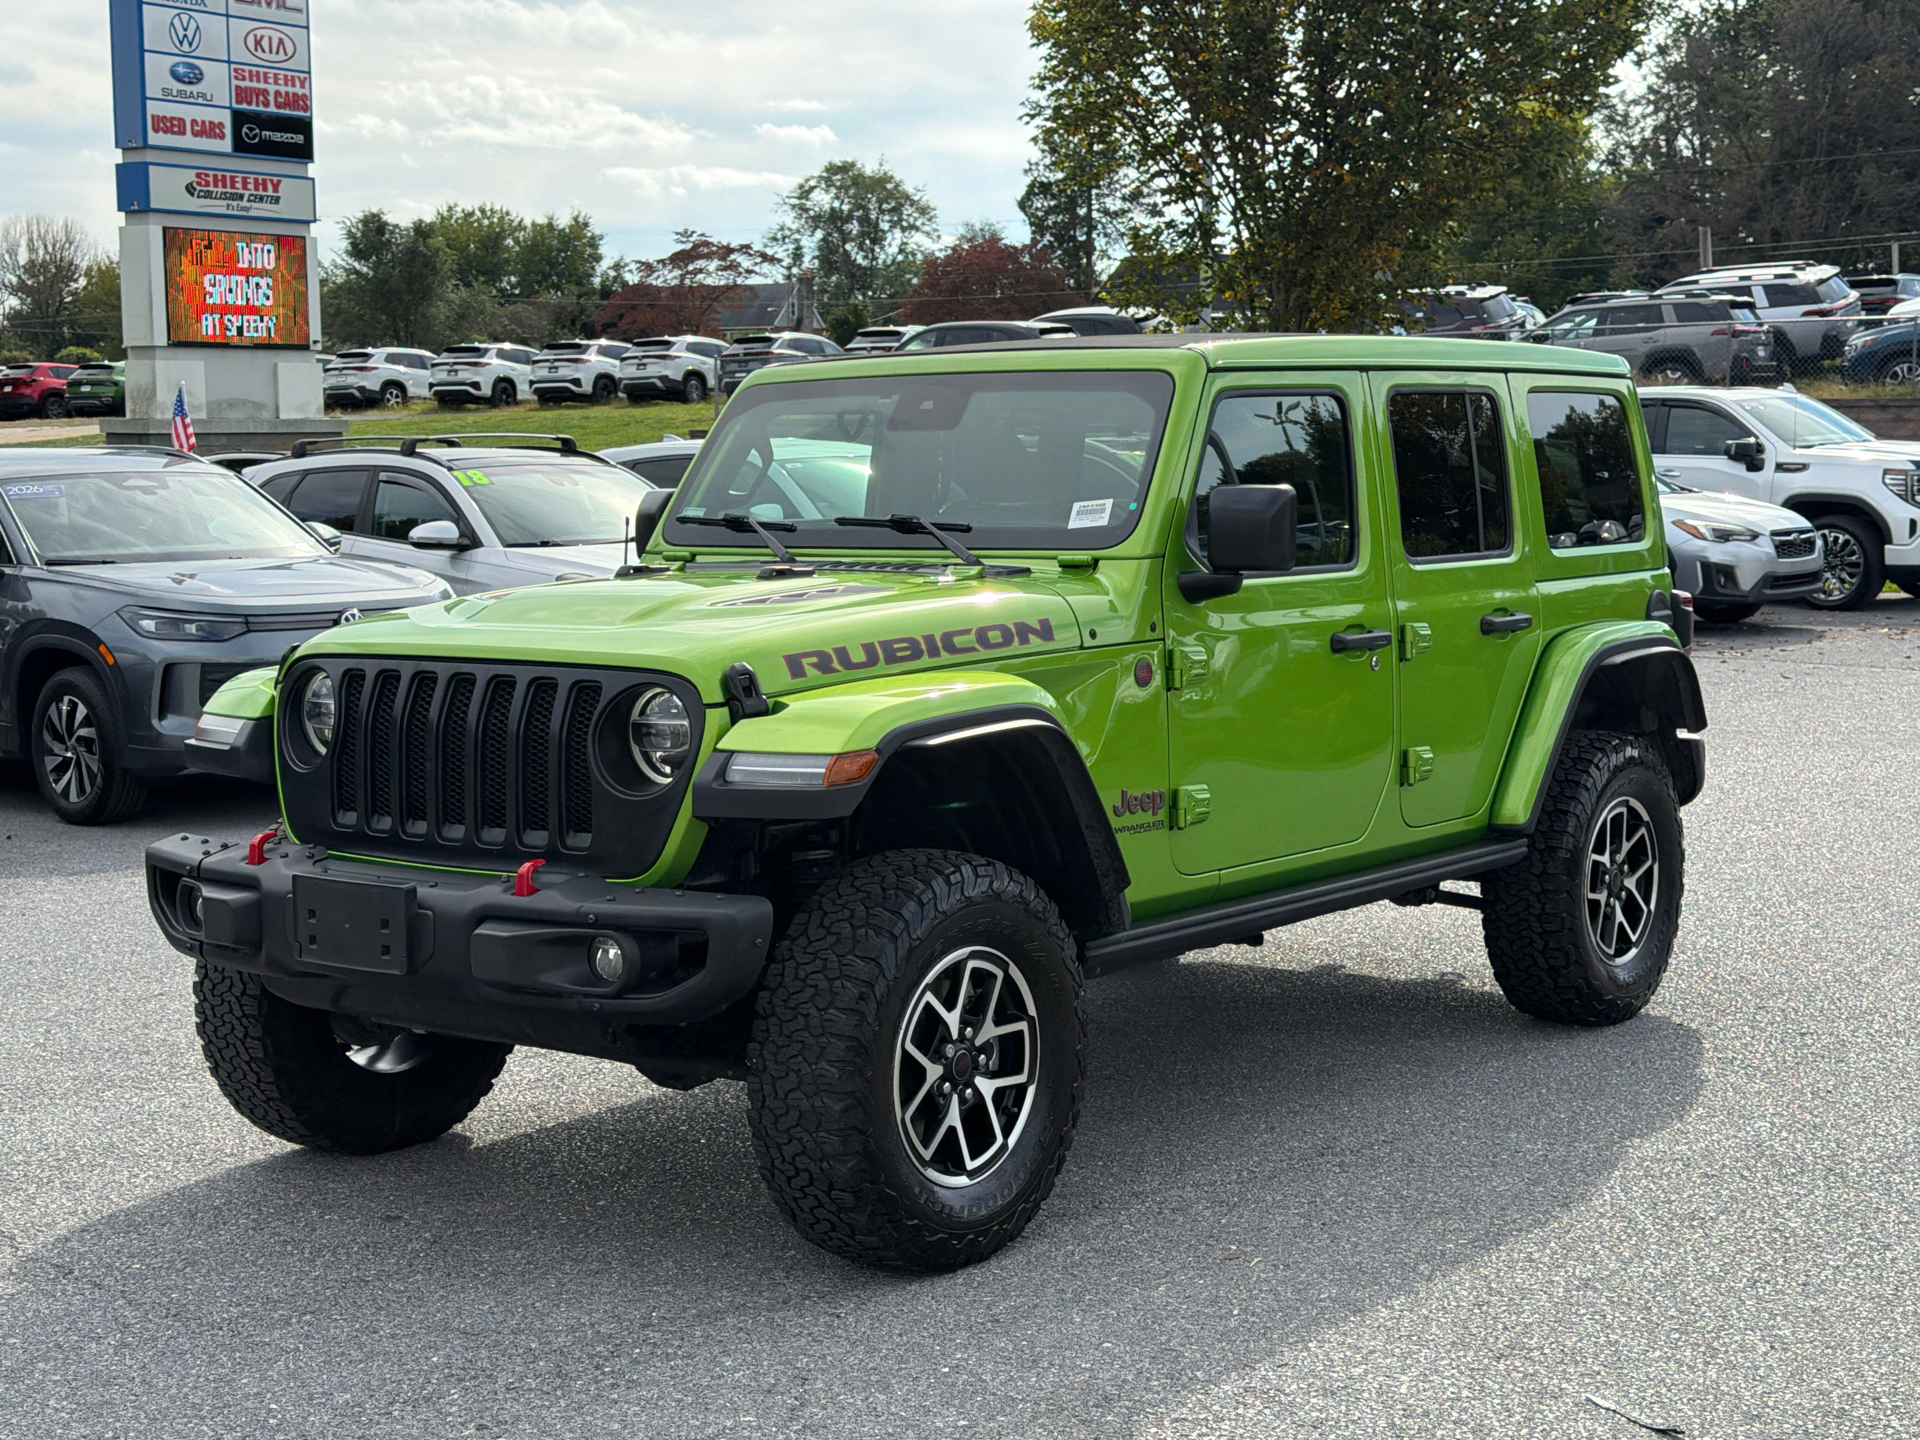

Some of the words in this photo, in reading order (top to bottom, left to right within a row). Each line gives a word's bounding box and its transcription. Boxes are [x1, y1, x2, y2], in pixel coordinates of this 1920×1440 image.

[253, 33, 289, 57] KIA
[233, 67, 309, 89] SHEEHY
[161, 87, 214, 102] SUBARU
[234, 84, 270, 108] BUYS
[273, 89, 309, 113] CARS
[151, 114, 187, 136] USED
[190, 118, 226, 141] CARS
[195, 171, 283, 194] SHEEHY
[196, 188, 246, 203] COLLISION
[246, 193, 281, 206] CENTER
[225, 203, 235, 212] It's
[453, 470, 491, 487] 18
[6, 484, 44, 496] 2026
[782, 617, 1056, 681] RUBICON
[1113, 788, 1166, 818] Jeep
[1113, 820, 1165, 834] WRANGLER
